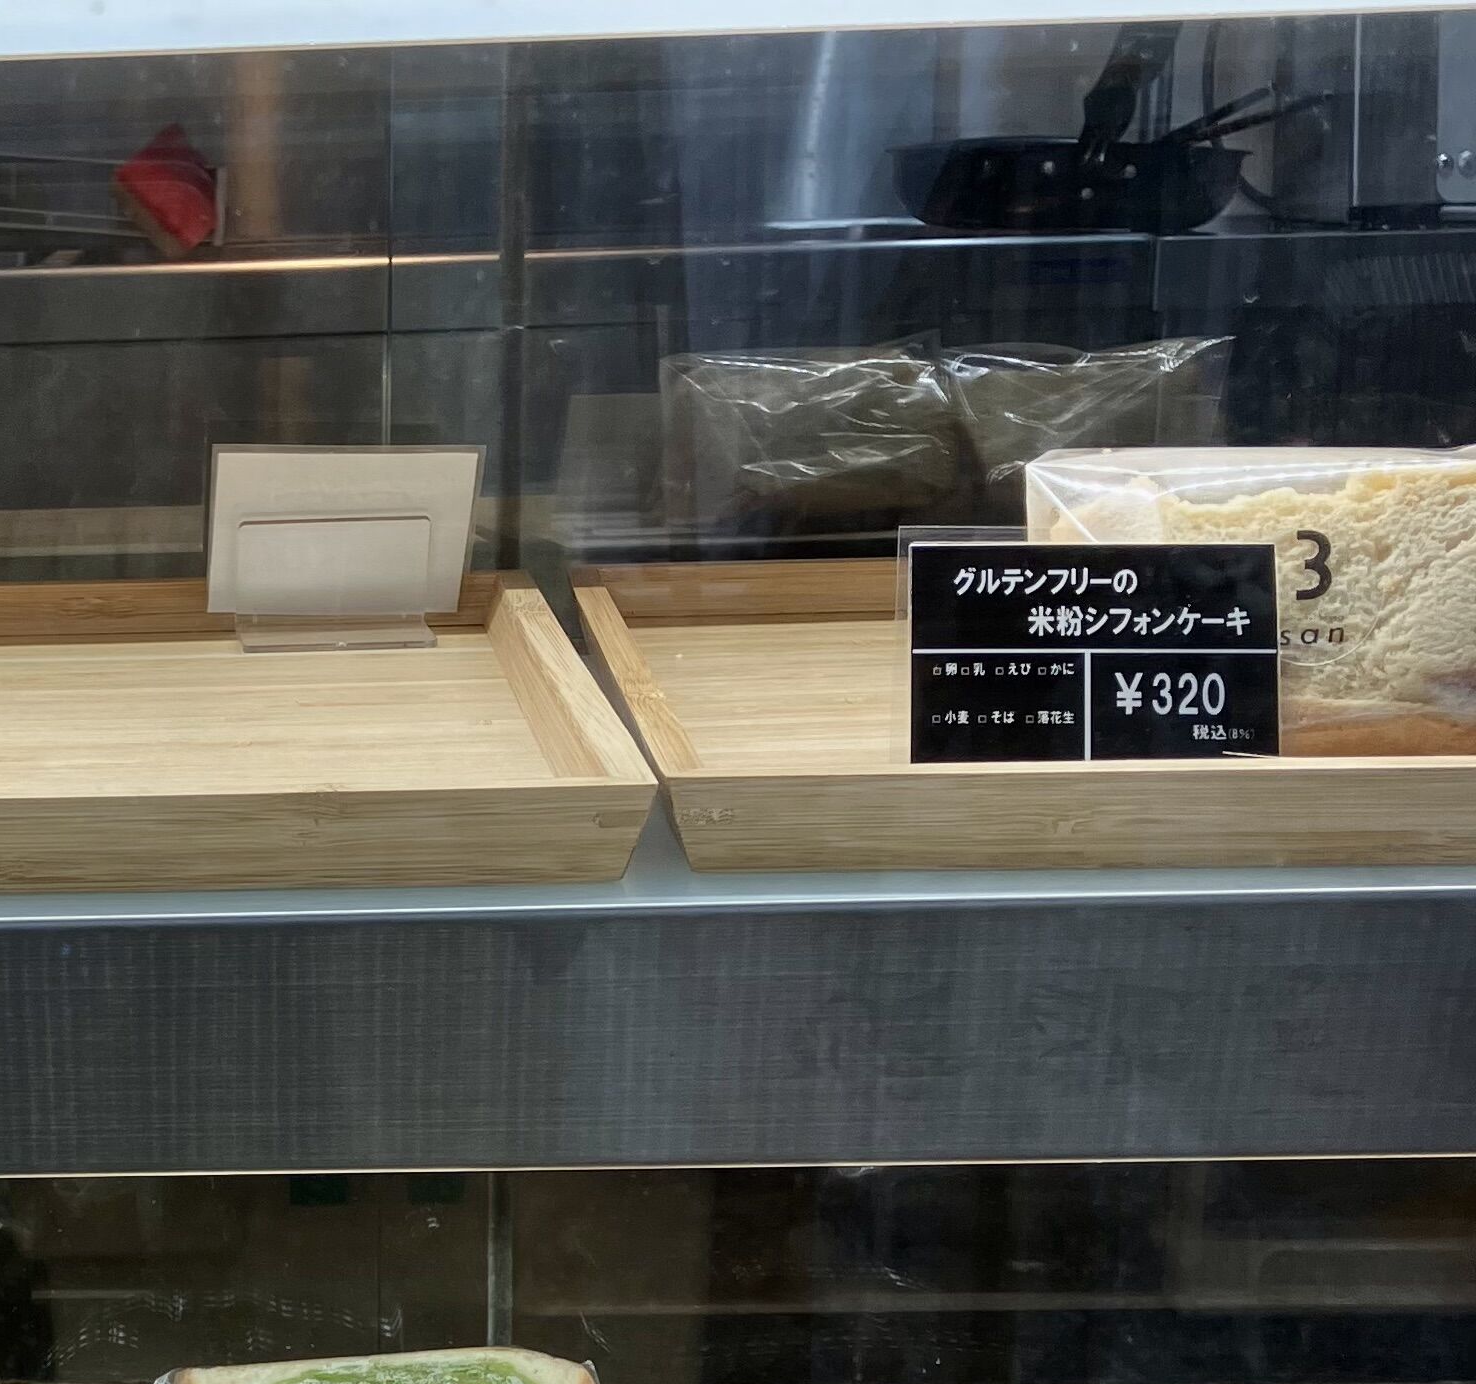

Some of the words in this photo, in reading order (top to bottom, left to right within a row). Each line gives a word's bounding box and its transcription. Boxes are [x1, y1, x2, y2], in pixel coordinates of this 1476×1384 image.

[1296, 530, 1332, 600] 3
[953, 567, 1139, 596] グルテンフリーの
[1028, 605, 1252, 637] 米粉シフォンケーキ
[1280, 627, 1345, 645] san
[1115, 671, 1226, 716] ¥320
